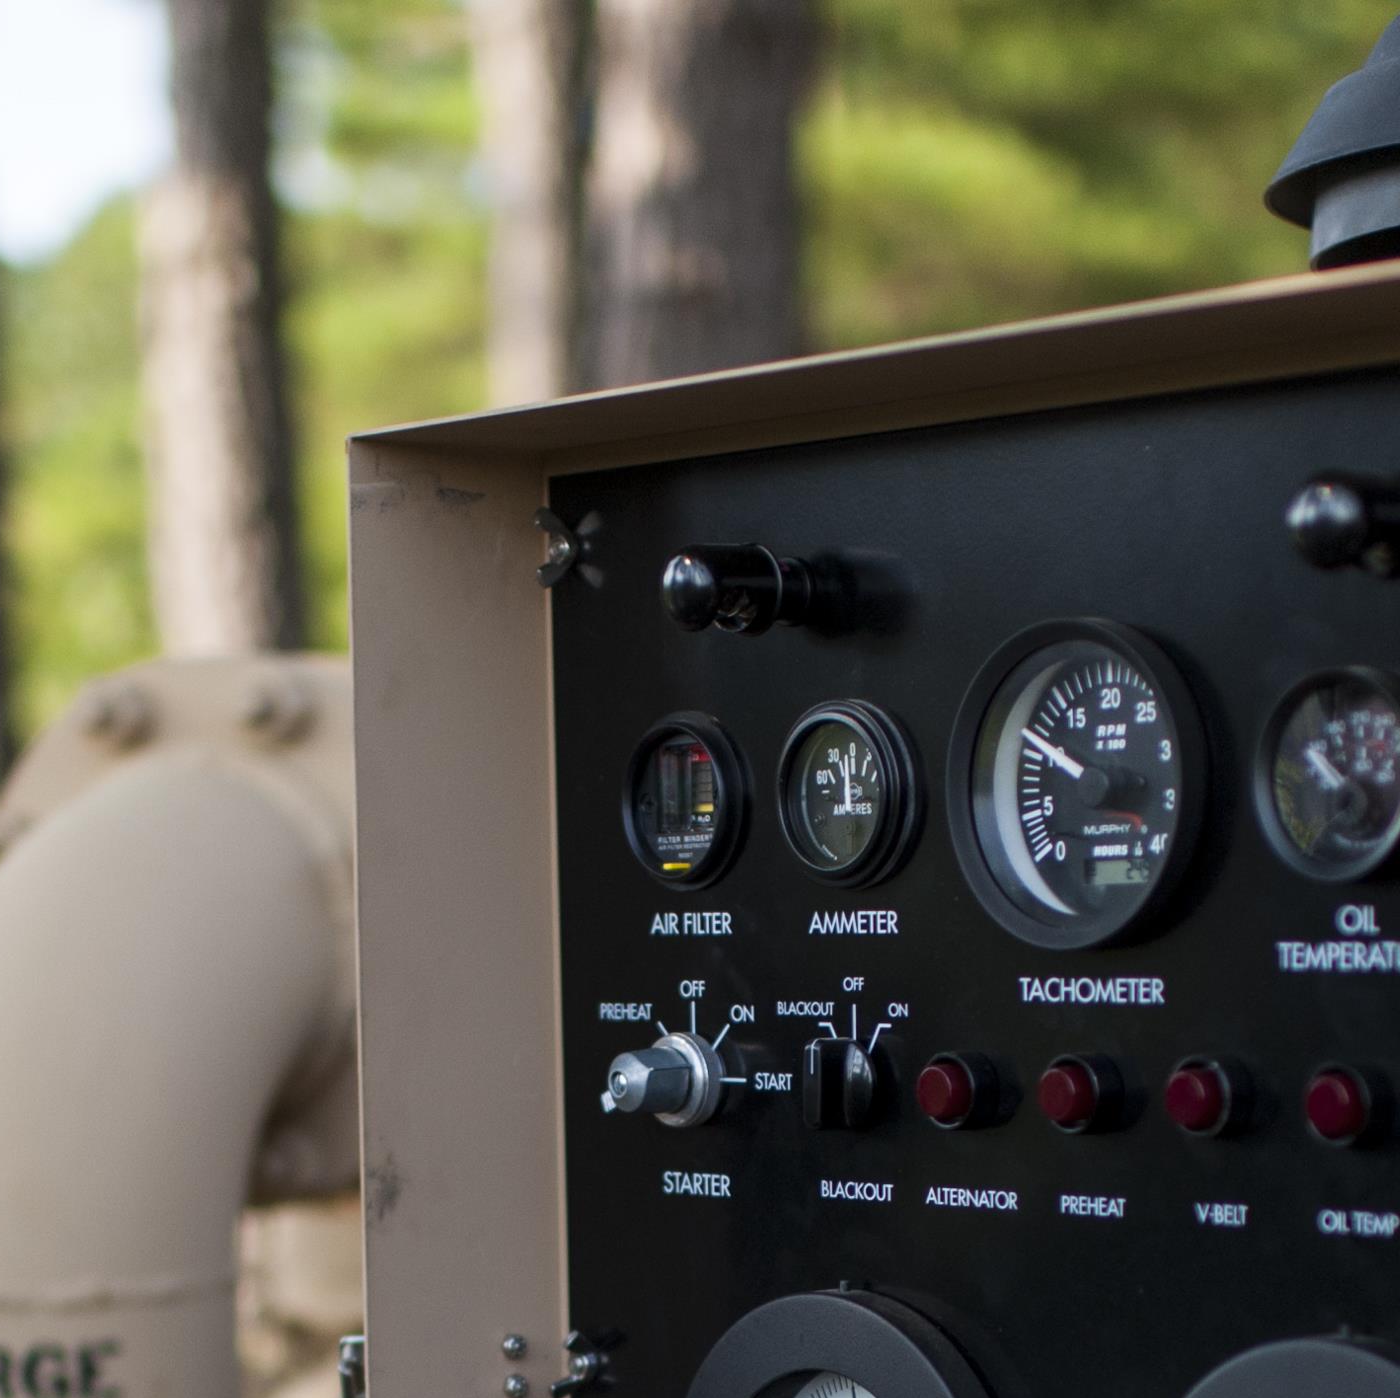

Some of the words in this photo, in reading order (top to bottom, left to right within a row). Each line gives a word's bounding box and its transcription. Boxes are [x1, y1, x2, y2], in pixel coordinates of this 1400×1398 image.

[1101, 688, 1120, 708] 20
[1066, 708, 1086, 728] 15
[1136, 702, 1156, 722] 25
[1097, 724, 1126, 737] RPM
[828, 748, 839, 763] 30
[850, 742, 855, 756] 0
[1160, 739, 1172, 760] 3
[817, 770, 828, 784] 60
[1043, 796, 1053, 816] 5
[1165, 788, 1175, 809] 3
[833, 803, 872, 815] AMERES
[1084, 824, 1131, 835] MURPHY
[1056, 840, 1066, 861] 0
[1093, 844, 1128, 856] HOURS
[651, 912, 680, 935] AIR
[684, 912, 733, 935] FILTER
[809, 911, 898, 934] AMMETER
[1335, 904, 1380, 936] OIL
[680, 980, 705, 997] OFF
[843, 977, 864, 992] OFF
[1019, 977, 1165, 1003] TACHOMETER
[600, 1003, 652, 1020] PREHEAT
[731, 1005, 754, 1022] ON
[777, 1001, 834, 1016] BLACKOUT
[888, 1003, 908, 1017] ON
[755, 1073, 792, 1091] START
[663, 1171, 731, 1197] STARTER
[821, 1180, 893, 1202] BLACKOUT
[926, 1187, 1018, 1210] ALTERNATOR
[1060, 1195, 1126, 1218] PREHEAT
[1195, 1202, 1248, 1227] V-BELT
[1317, 1209, 1350, 1234] OIL
[1353, 1210, 1400, 1236] TEMP
